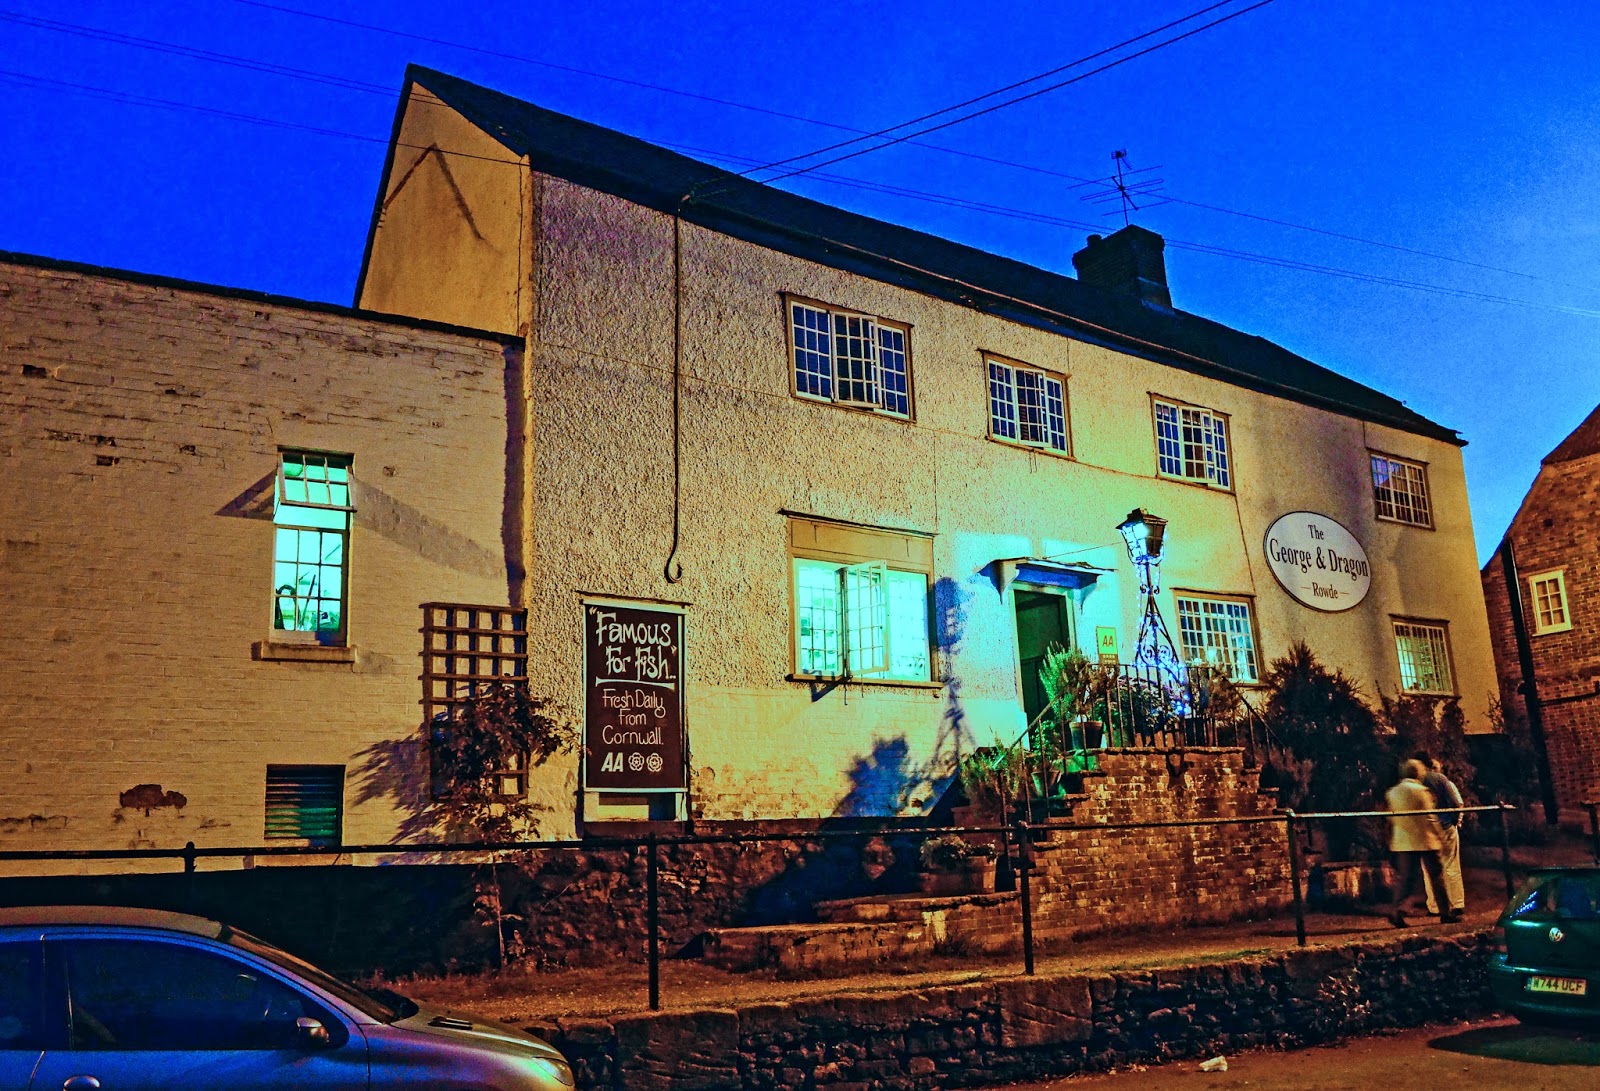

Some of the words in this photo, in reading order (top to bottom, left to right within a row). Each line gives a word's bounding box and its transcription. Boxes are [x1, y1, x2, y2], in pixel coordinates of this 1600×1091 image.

[1308, 524, 1324, 540] The
[1270, 538, 1312, 573] George
[1316, 546, 1326, 570] &
[1328, 549, 1369, 581] Dragon
[1312, 582, 1338, 599] Rowde
[1103, 635, 1114, 647] AA
[606, 645, 631, 676] For
[602, 688, 634, 709] Fresh
[635, 689, 666, 719] Daily
[618, 708, 647, 726] From
[602, 724, 664, 745] Cornwall.
[601, 752, 624, 773] AA
